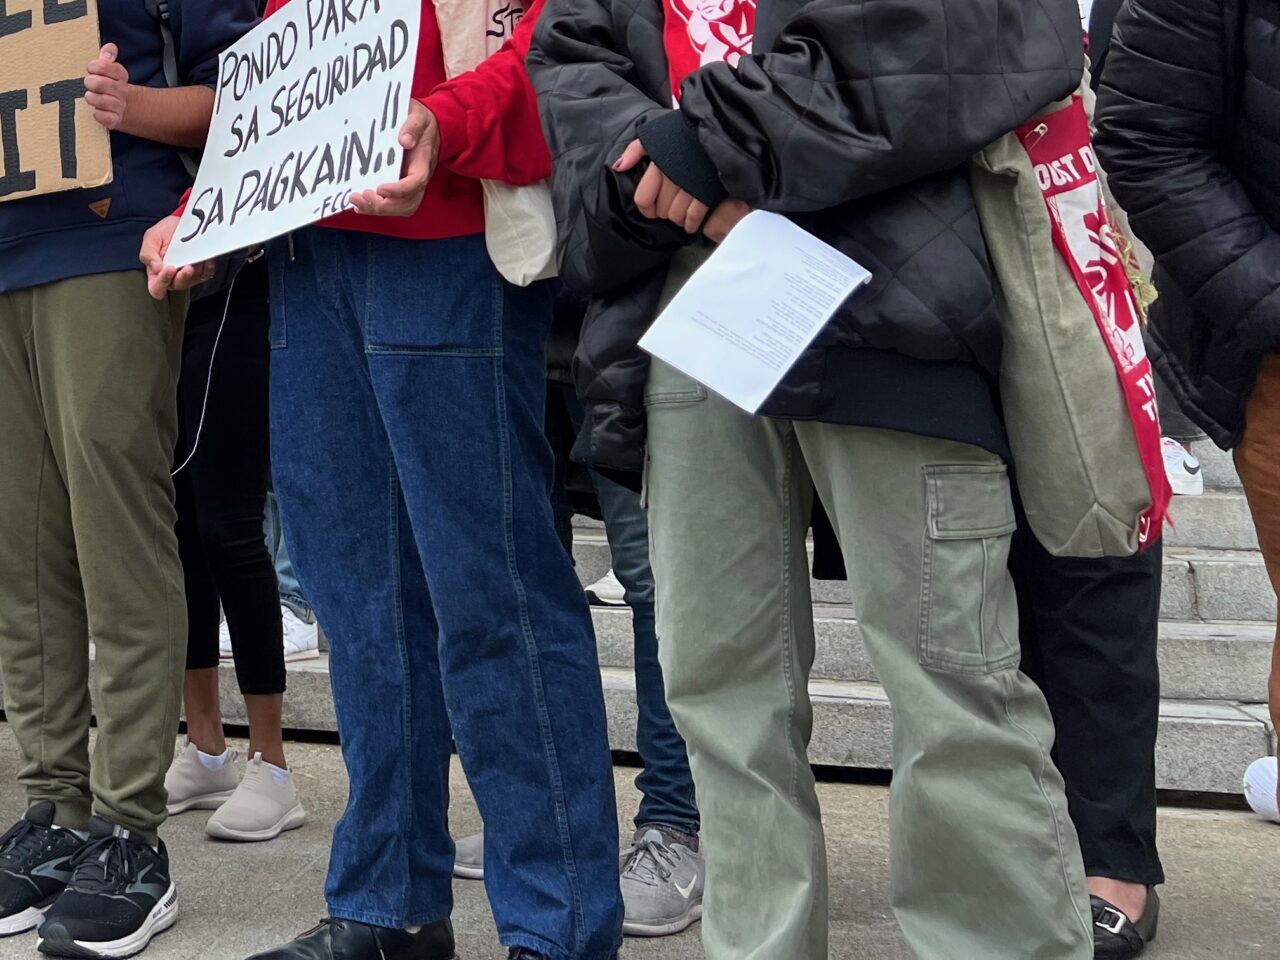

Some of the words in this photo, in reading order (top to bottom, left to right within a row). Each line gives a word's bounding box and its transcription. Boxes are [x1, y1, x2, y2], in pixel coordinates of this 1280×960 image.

[216, 21, 298, 115] PONDO
[224, 105, 260, 158] SA
[181, 187, 224, 243] SA
